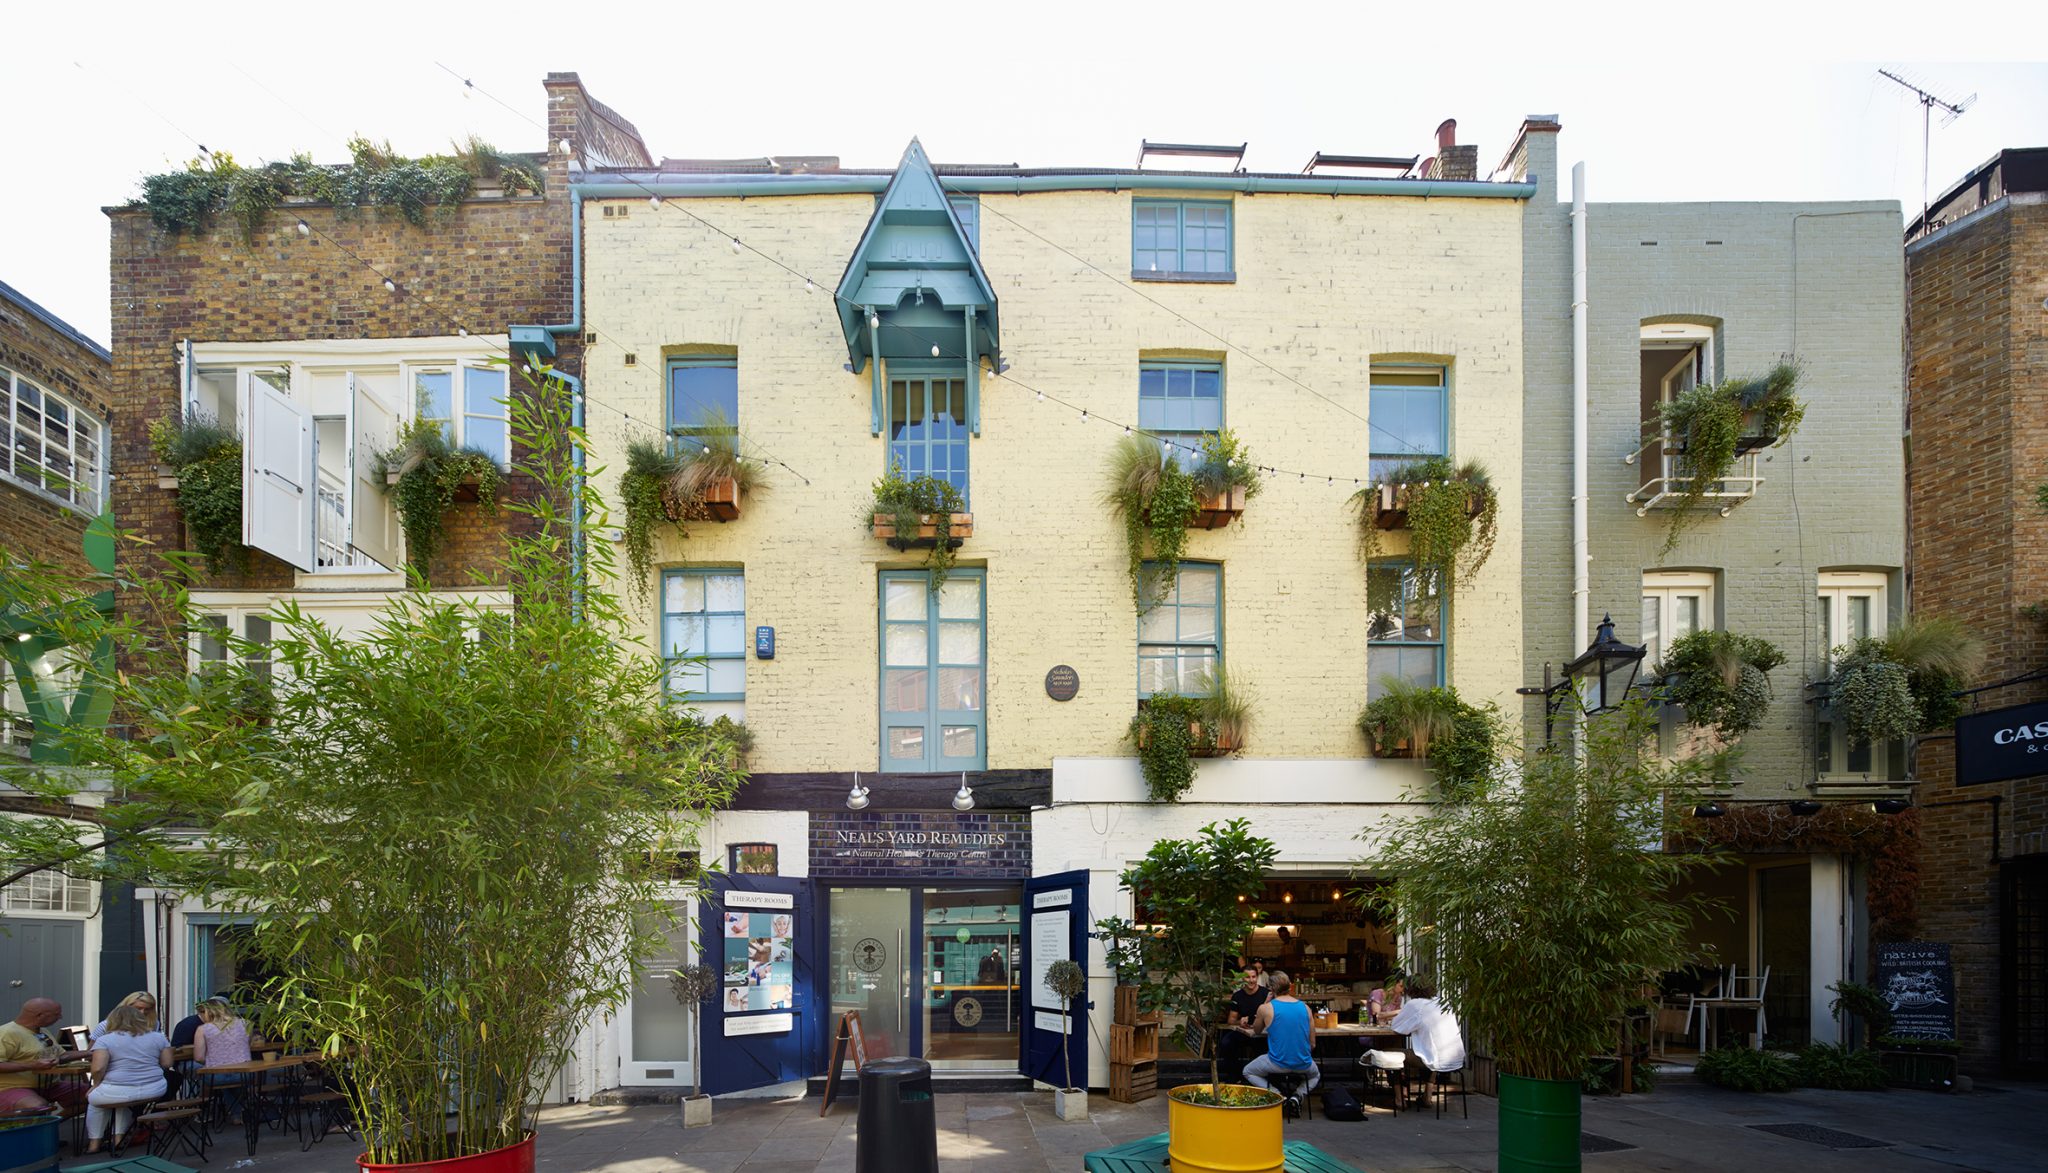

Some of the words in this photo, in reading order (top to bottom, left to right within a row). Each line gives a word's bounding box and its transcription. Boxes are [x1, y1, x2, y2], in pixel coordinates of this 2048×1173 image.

[2027, 744, 2039, 754] &
[836, 830, 885, 844] NEAL'S
[888, 831, 926, 844] YARD
[930, 831, 1005, 845] REMEDIES
[852, 848, 884, 858] Natural
[927, 849, 959, 860] Therapy
[731, 895, 763, 904] THERAPY
[764, 897, 788, 905] ROOMS
